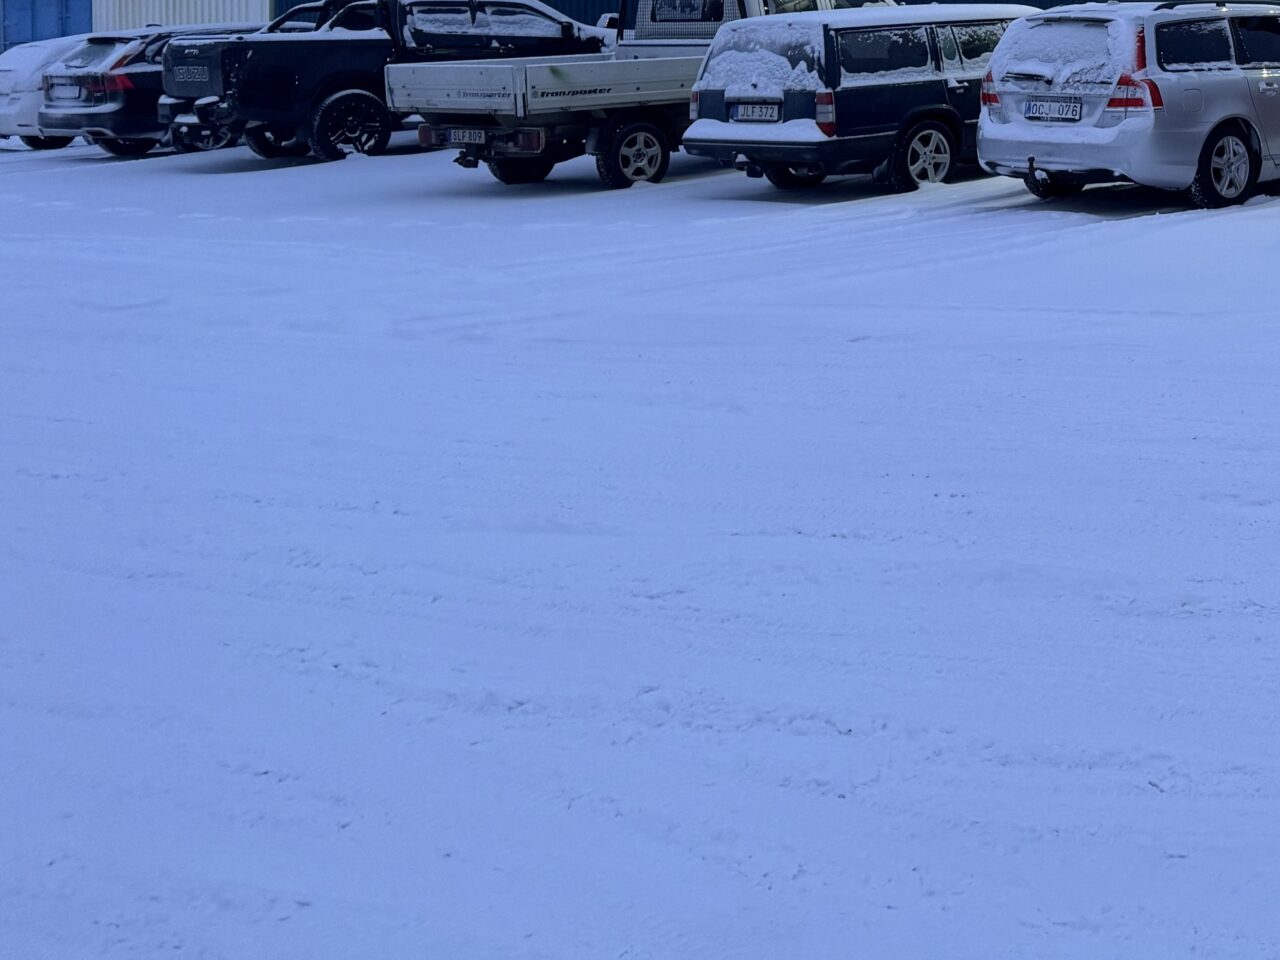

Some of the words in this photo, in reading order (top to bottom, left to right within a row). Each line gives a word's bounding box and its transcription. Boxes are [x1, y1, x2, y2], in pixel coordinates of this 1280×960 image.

[173, 66, 209, 82] ISUZU
[540, 87, 613, 98] Transporter
[758, 106, 775, 118] 372
[1058, 104, 1078, 117] 076
